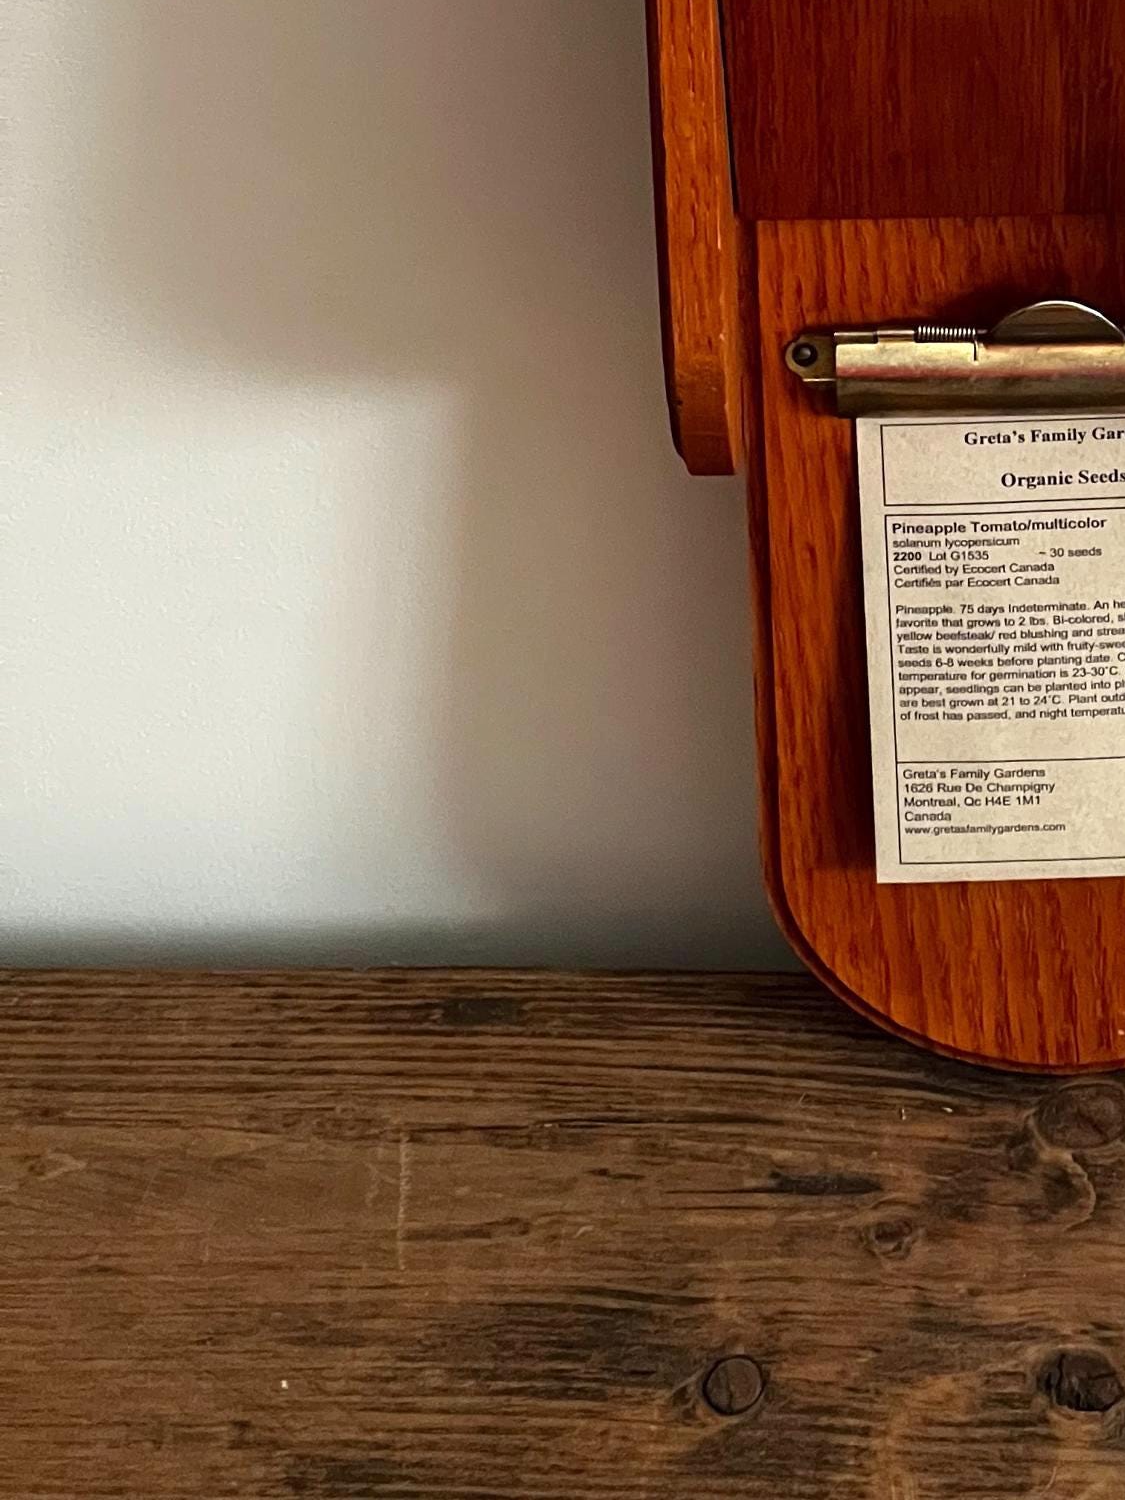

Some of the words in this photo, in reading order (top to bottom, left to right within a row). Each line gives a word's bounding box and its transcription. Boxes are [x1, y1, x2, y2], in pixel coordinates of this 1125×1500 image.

[964, 431, 1025, 445] Greta's
[1030, 428, 1087, 443] Family
[1001, 471, 1073, 489] Organic
[891, 522, 967, 536] Pineapple
[969, 517, 1107, 532] Tomato/multicolor
[892, 539, 942, 548] solanum
[944, 537, 1020, 549] lycopersicum
[892, 552, 924, 562] 2200
[928, 551, 947, 561] Lot
[1049, 547, 1065, 558] 30
[1067, 547, 1102, 557] seeds
[893, 564, 942, 575] Certified
[944, 564, 959, 577] by
[962, 563, 1006, 574] Ecocert
[1009, 562, 1055, 573] Canada
[945, 579, 965, 590] par
[967, 577, 1011, 588] Ecocert
[1014, 575, 1060, 586] Canada
[959, 603, 974, 614] 75
[977, 604, 1005, 616] days
[1093, 600, 1109, 610] An
[941, 618, 964, 628] that
[966, 616, 1001, 628] grows
[1004, 617, 1015, 627] to
[1018, 616, 1026, 627] 2
[896, 631, 933, 643] yellow
[998, 630, 1017, 640] red
[1020, 628, 1068, 639] blushing
[1071, 627, 1093, 637] and
[896, 645, 929, 654] Taste
[932, 644, 942, 654] is
[944, 643, 1010, 654] wonderfully
[1013, 642, 1037, 653] mild
[1040, 641, 1065, 652] with
[897, 658, 932, 668] seeds
[935, 657, 954, 668] 6-8
[956, 657, 994, 667] weeks
[997, 656, 1034, 667] before
[1037, 655, 1082, 666] planting
[898, 671, 967, 682] temperature
[970, 670, 987, 680] for
[989, 669, 1056, 682] germination
[1059, 668, 1069, 678] is
[898, 686, 943, 697] appear,
[945, 684, 1000, 695] seedlings
[1003, 685, 1024, 693] can
[1027, 682, 1042, 692] be
[1045, 681, 1087, 692] planted
[1090, 679, 1111, 690] into
[899, 699, 918, 708] are
[921, 697, 946, 708] best
[948, 699, 984, 709] grown
[987, 697, 999, 707] at
[1001, 696, 1015, 706] 21
[1019, 696, 1031, 706] to
[1068, 693, 1097, 704] Plant
[900, 710, 912, 721] of
[914, 710, 939, 721] frost
[942, 708, 963, 721] has
[966, 709, 1011, 722] passed,
[1014, 709, 1036, 719] and
[1039, 708, 1068, 719] night
[902, 769, 947, 779] Greta's
[950, 768, 990, 781] Family
[993, 768, 1046, 779] Gardens
[904, 783, 933, 793] 1626
[936, 782, 962, 793] Rue
[965, 782, 983, 793] De
[986, 782, 1055, 793] Champigny
[904, 796, 960, 808] Montreal,
[963, 796, 982, 807] Qc
[985, 795, 1011, 806] H4E
[1015, 794, 1040, 805] 1M1
[904, 811, 952, 822] Canada
[904, 824, 1066, 835] www.gretasfamilygardens.com
